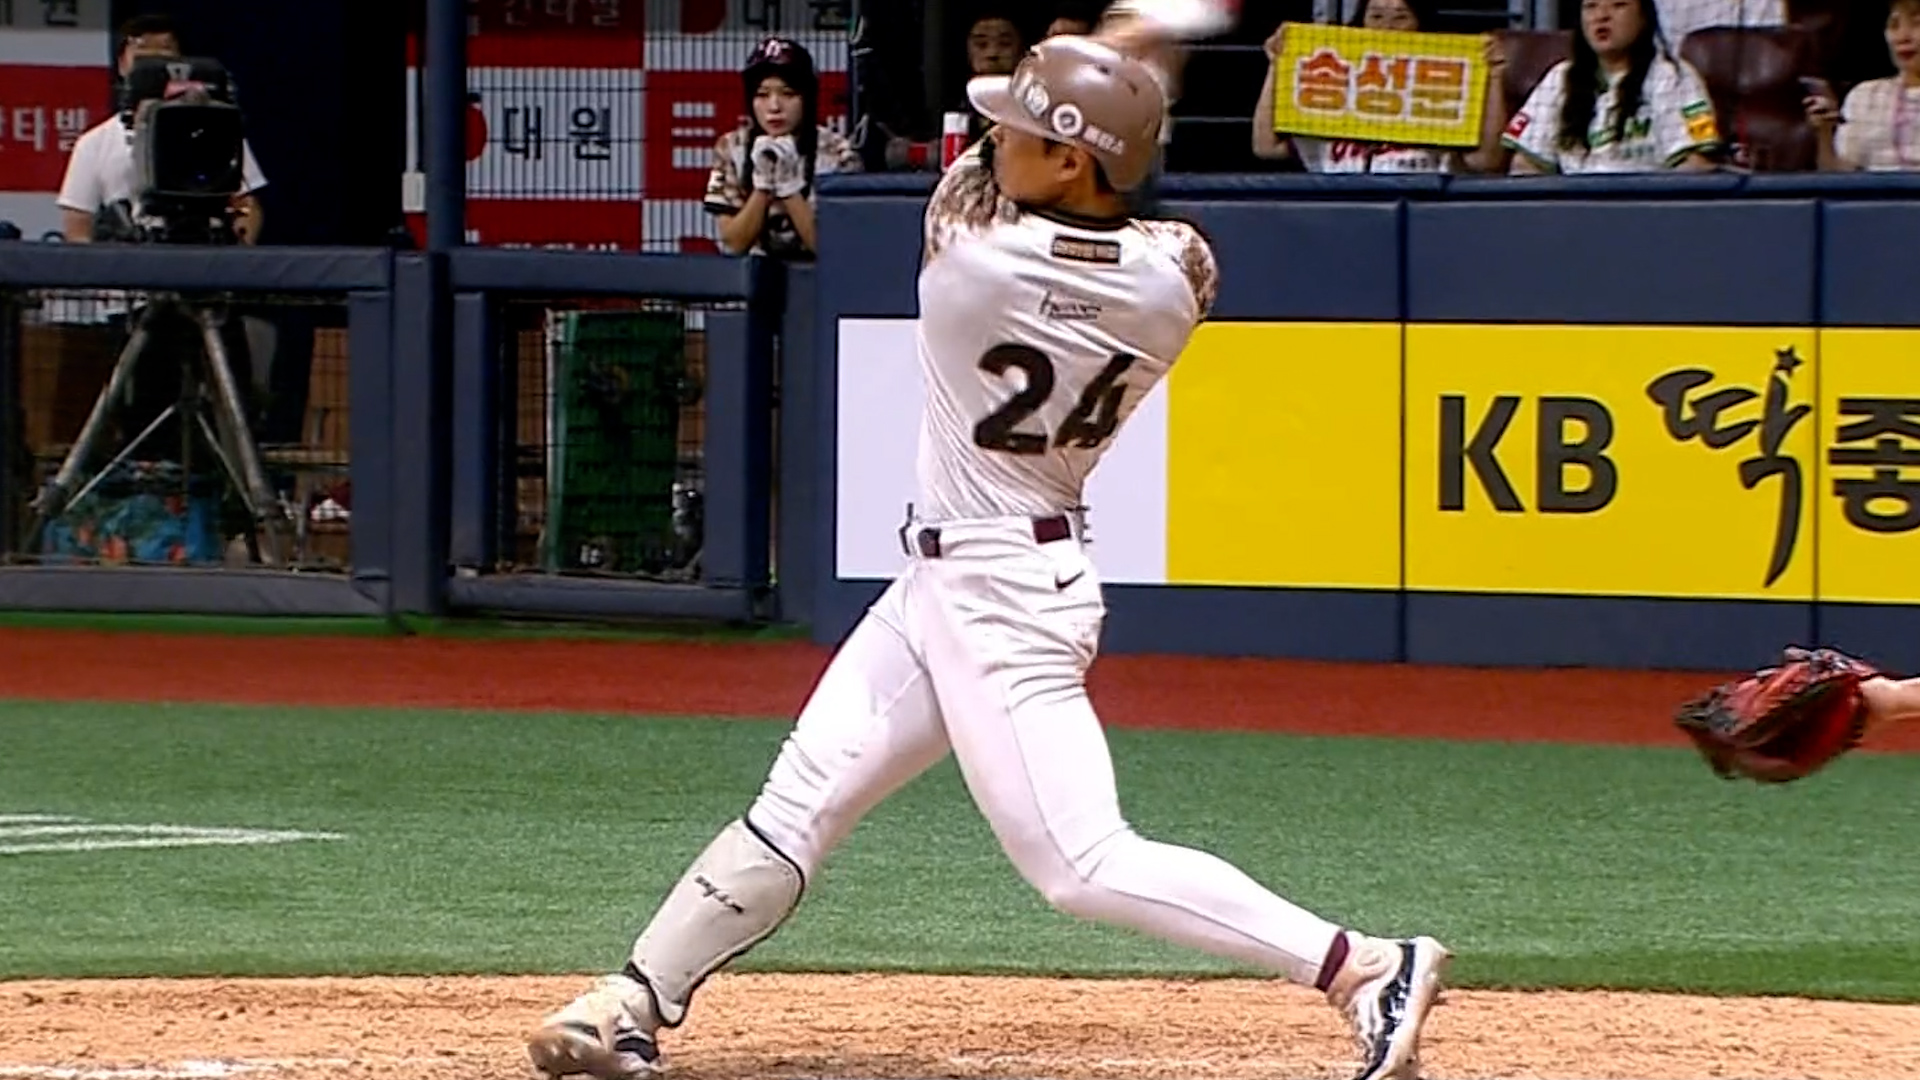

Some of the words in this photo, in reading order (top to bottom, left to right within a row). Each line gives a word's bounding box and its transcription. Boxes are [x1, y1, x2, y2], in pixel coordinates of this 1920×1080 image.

[1296, 48, 1469, 125] 송성문
[0, 106, 89, 153] 타빌
[502, 105, 612, 161] 대원
[973, 343, 1136, 456] 24
[1437, 394, 1619, 513] KB
